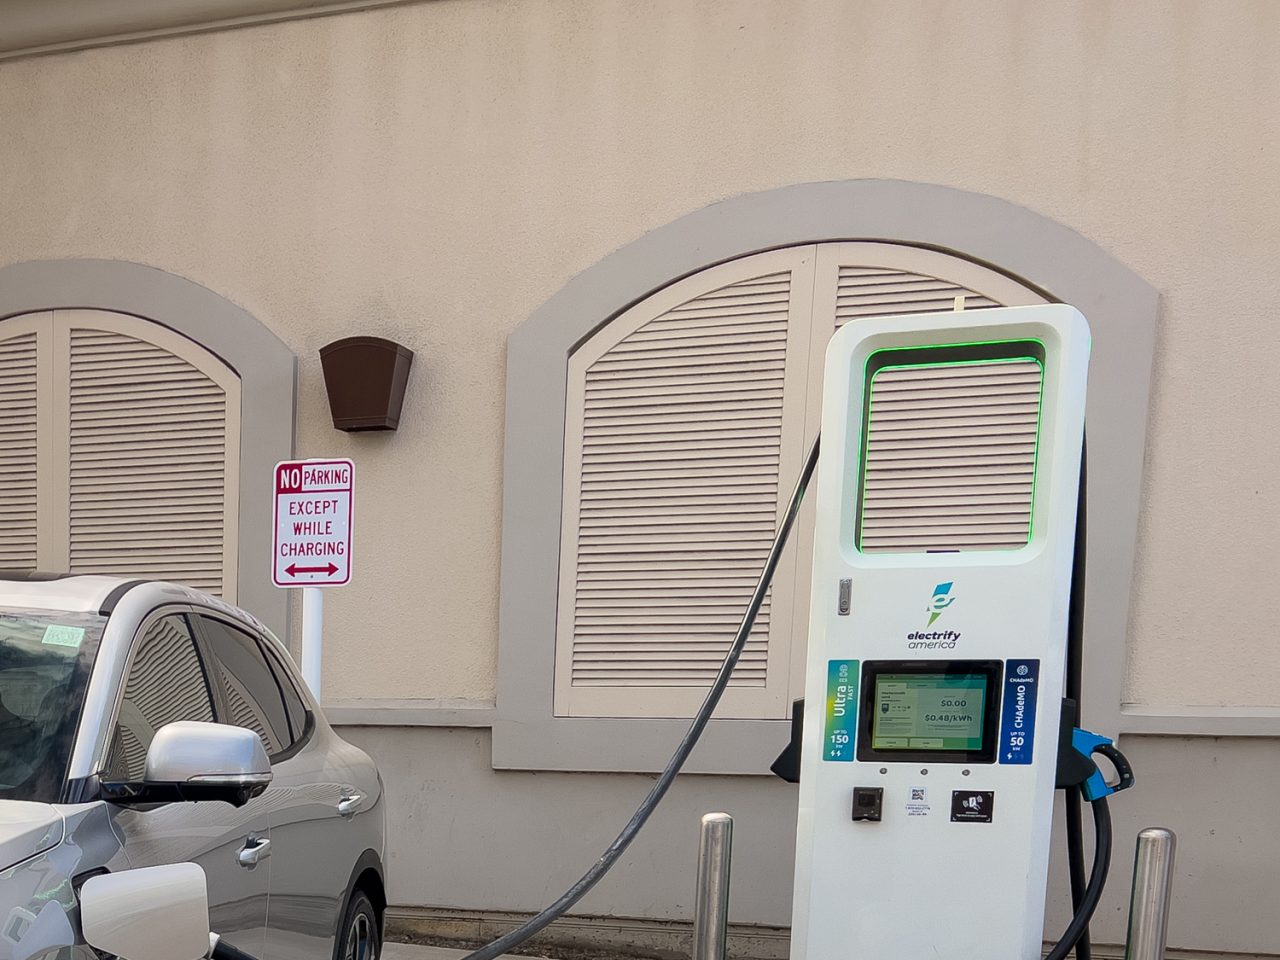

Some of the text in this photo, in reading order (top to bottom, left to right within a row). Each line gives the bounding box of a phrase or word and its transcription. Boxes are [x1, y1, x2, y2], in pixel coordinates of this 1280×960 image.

[280, 469, 348, 489] NO PARKING
[289, 500, 338, 515] EXCEPT
[293, 521, 333, 535] WHILE
[280, 541, 344, 556] CHARGING
[907, 631, 961, 641] electrify
[908, 641, 956, 649] america
[833, 685, 847, 717] Ultra
[1014, 685, 1026, 728] CHAdeMO
[925, 714, 973, 722] $0.48/kWh
[831, 735, 849, 743] 150
[1010, 737, 1024, 746] 50
